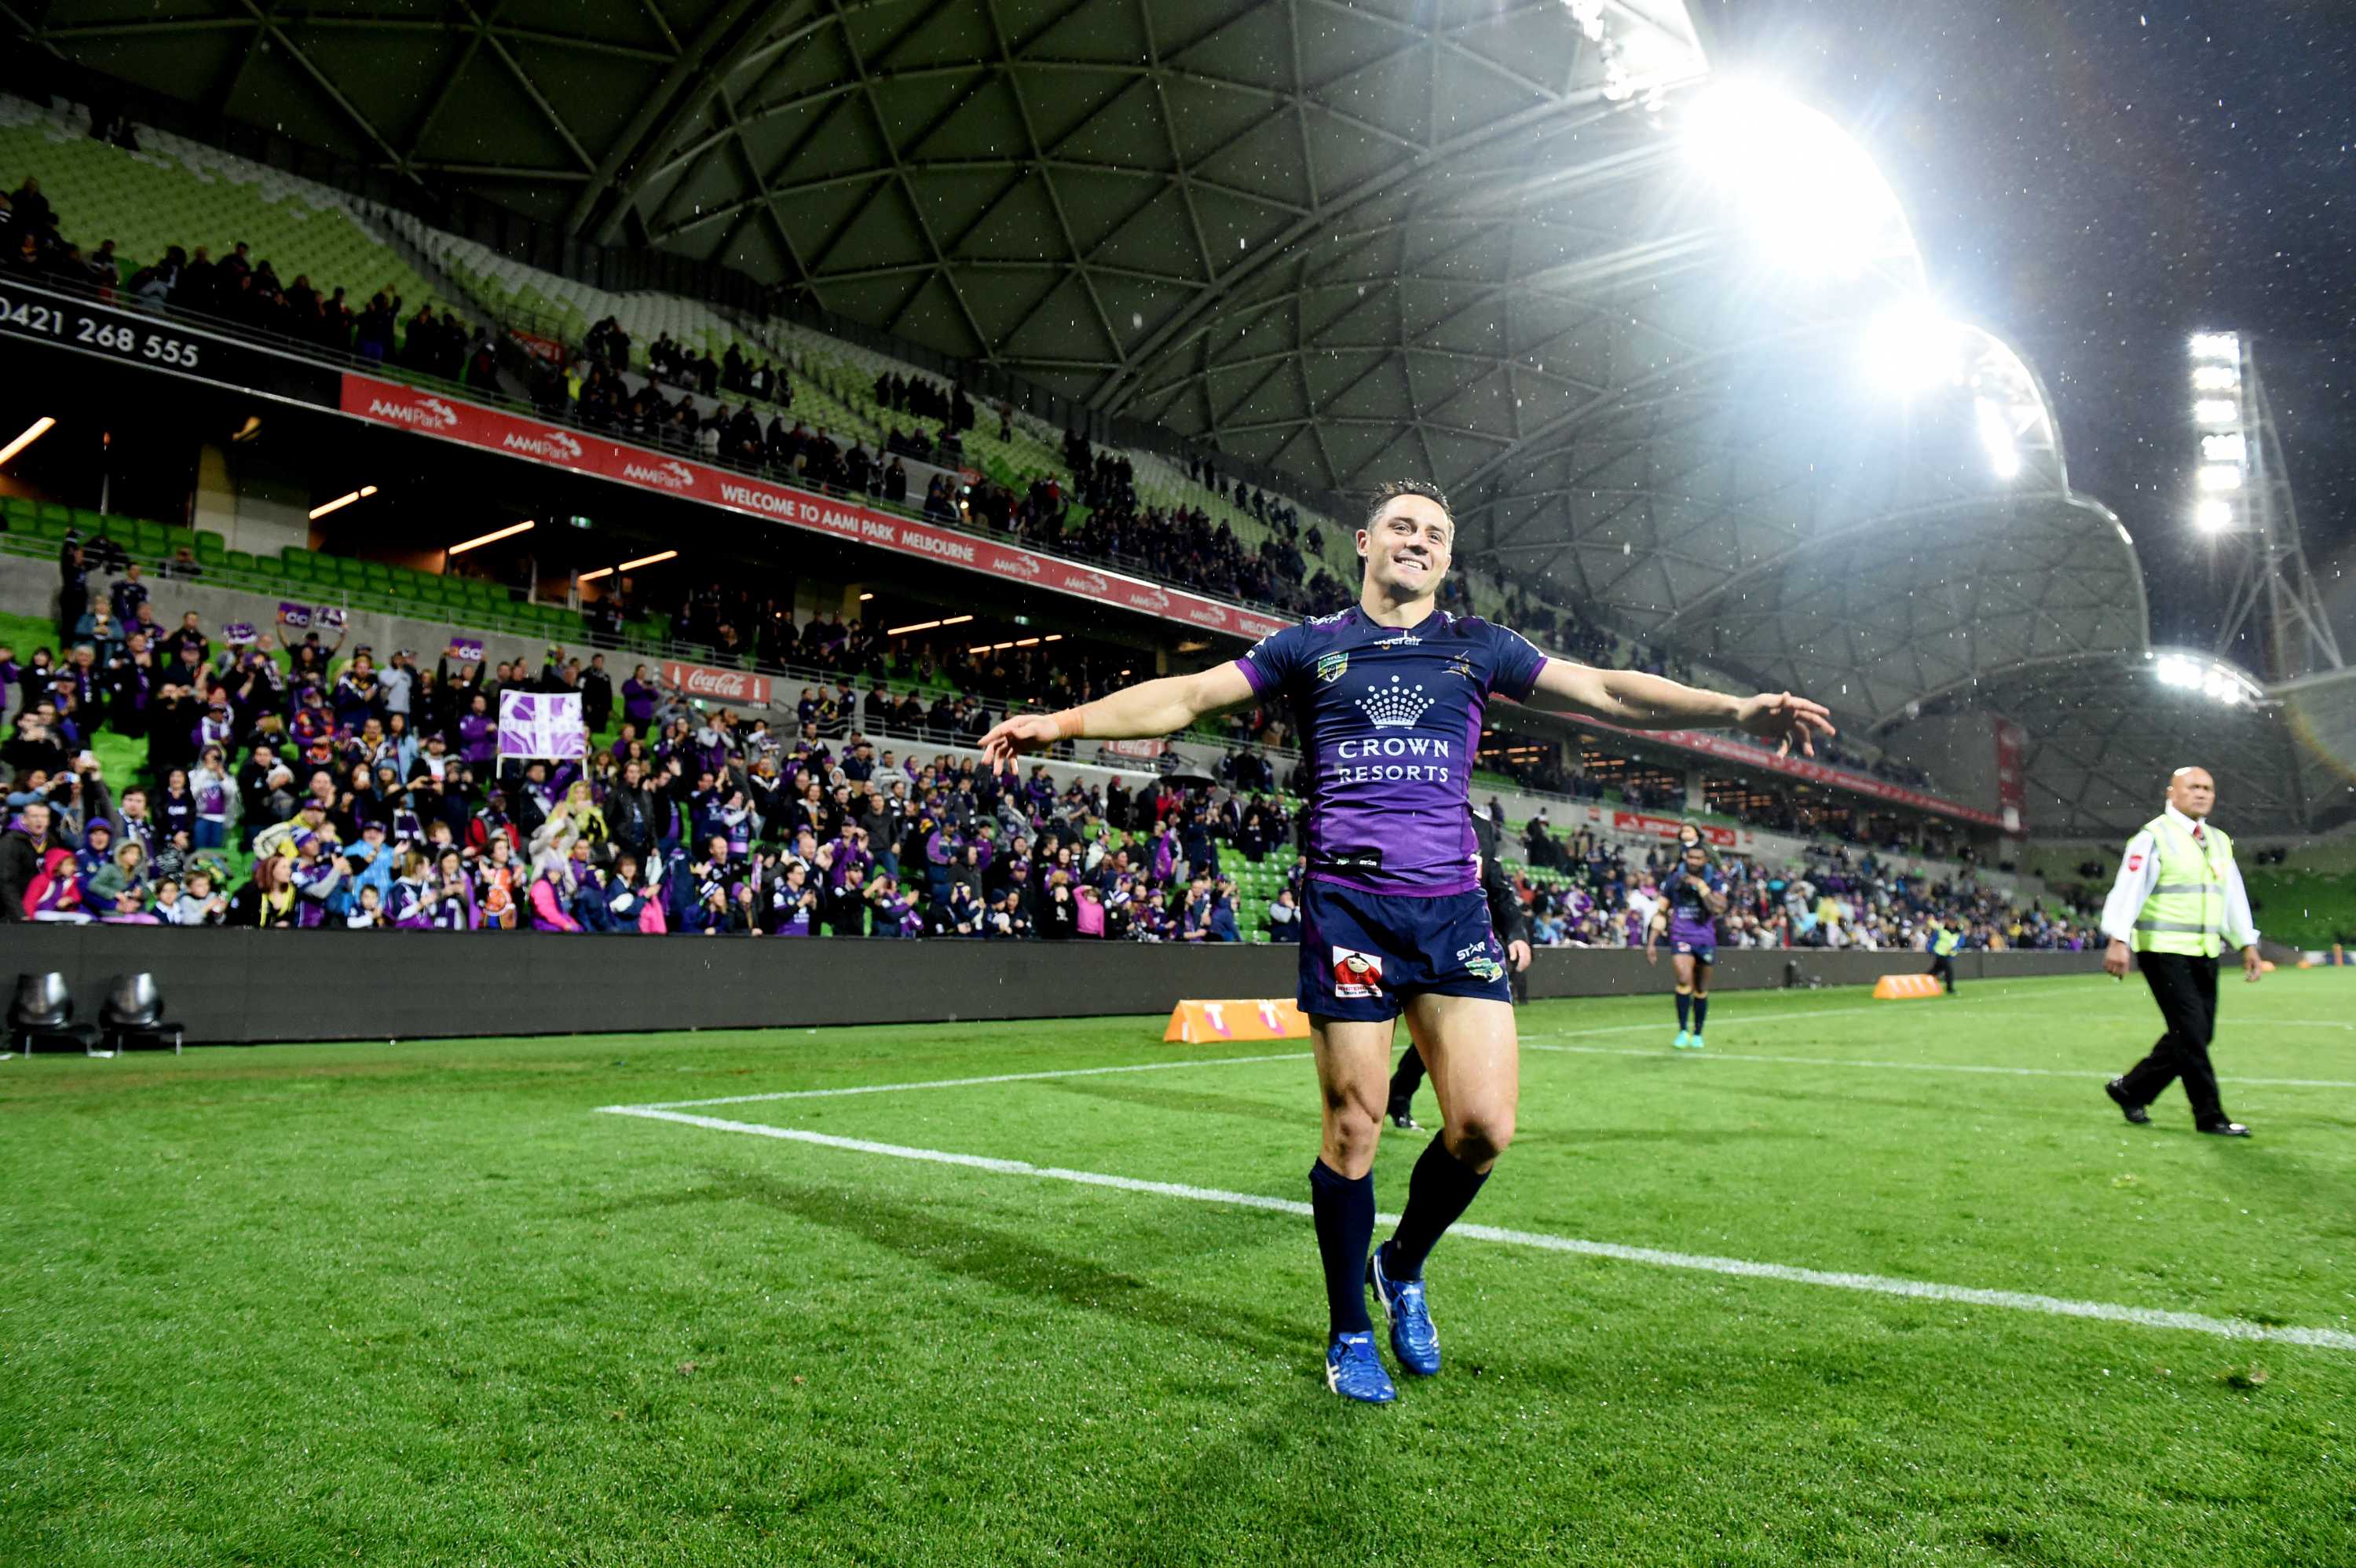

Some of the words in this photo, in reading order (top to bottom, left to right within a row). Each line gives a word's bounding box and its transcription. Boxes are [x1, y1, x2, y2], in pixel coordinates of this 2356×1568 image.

[76, 317, 135, 352] 268
[142, 334, 199, 367] 555
[720, 483, 796, 517] WELCOME
[799, 503, 820, 523] TO
[821, 510, 859, 532] AAMI
[862, 520, 895, 542] PARK
[902, 530, 975, 563] MELBOURNE
[1338, 737, 1450, 758] CROWN
[1338, 765, 1449, 784] RESORTS
[1456, 941, 1486, 961] STAR
